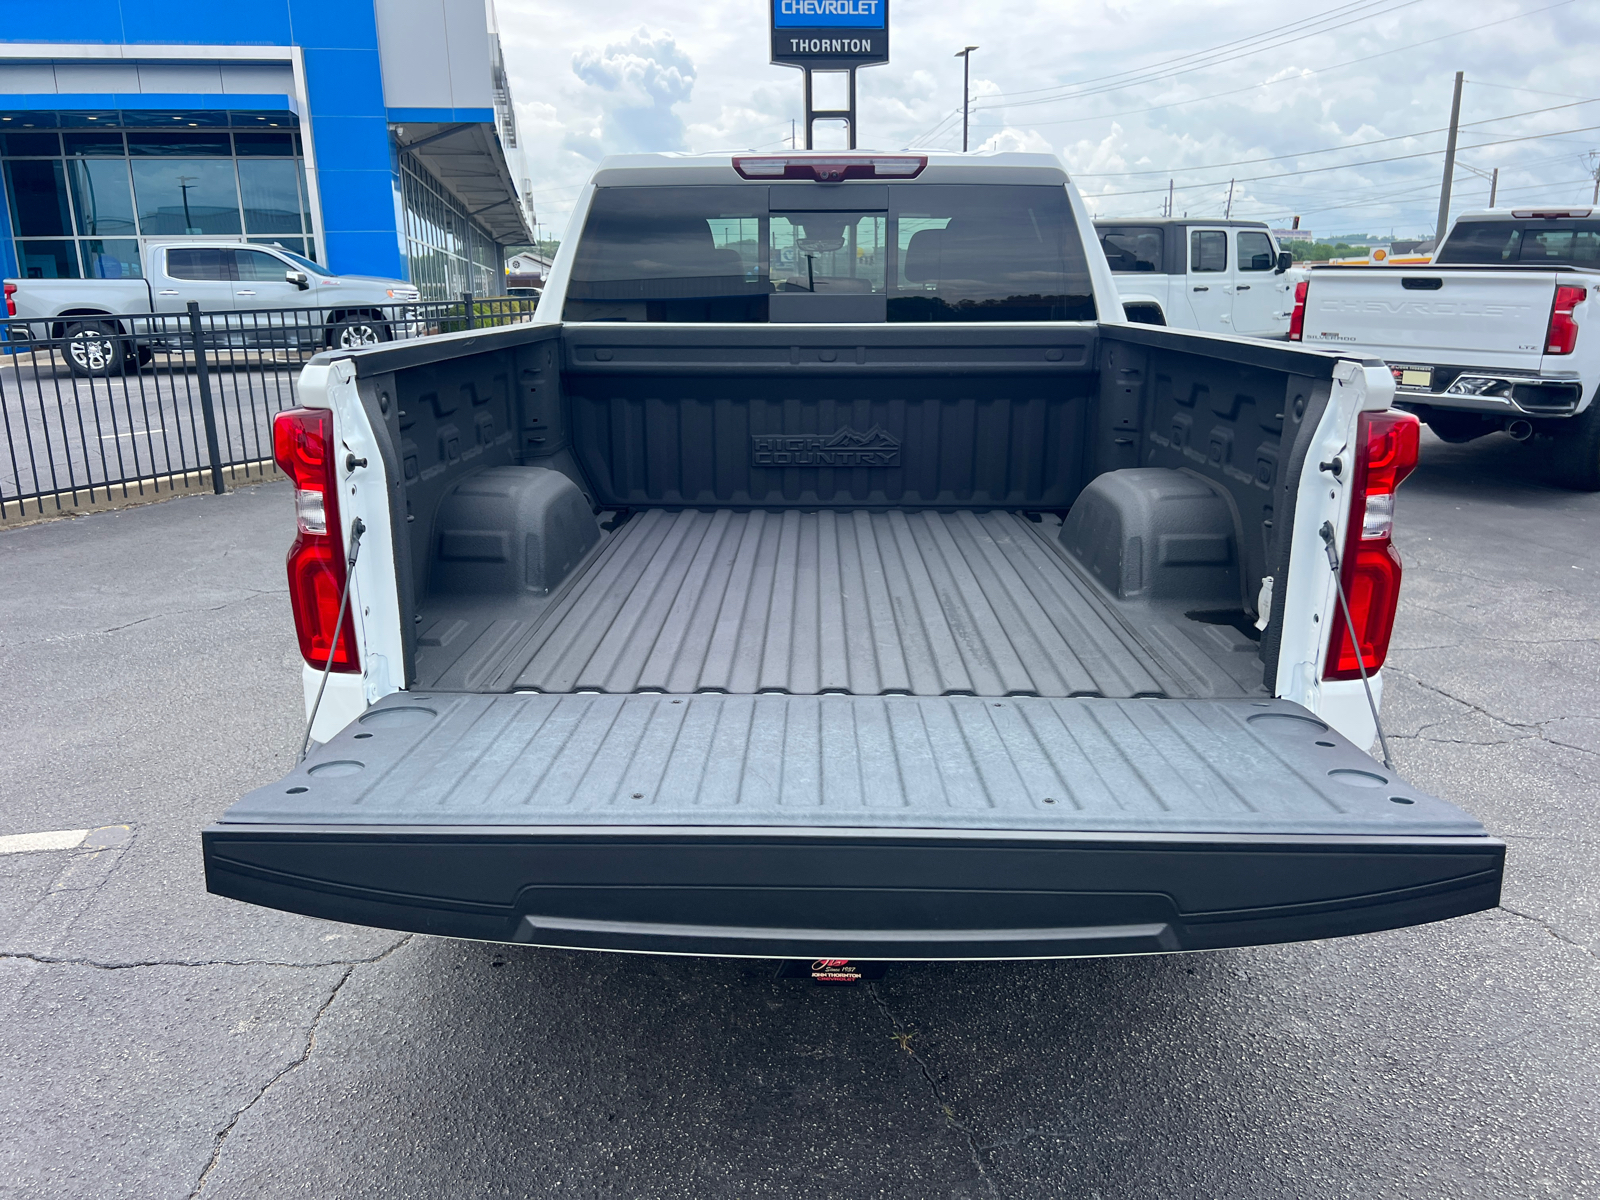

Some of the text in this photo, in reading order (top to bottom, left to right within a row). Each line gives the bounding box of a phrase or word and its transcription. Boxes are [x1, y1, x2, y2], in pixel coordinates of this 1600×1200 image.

[781, 0, 879, 15] CHEVROLET
[790, 39, 871, 52] THORNTON
[1319, 299, 1531, 318] CHEVROLET
[754, 438, 826, 450] HIGH
[754, 452, 898, 464] COUNTRY
